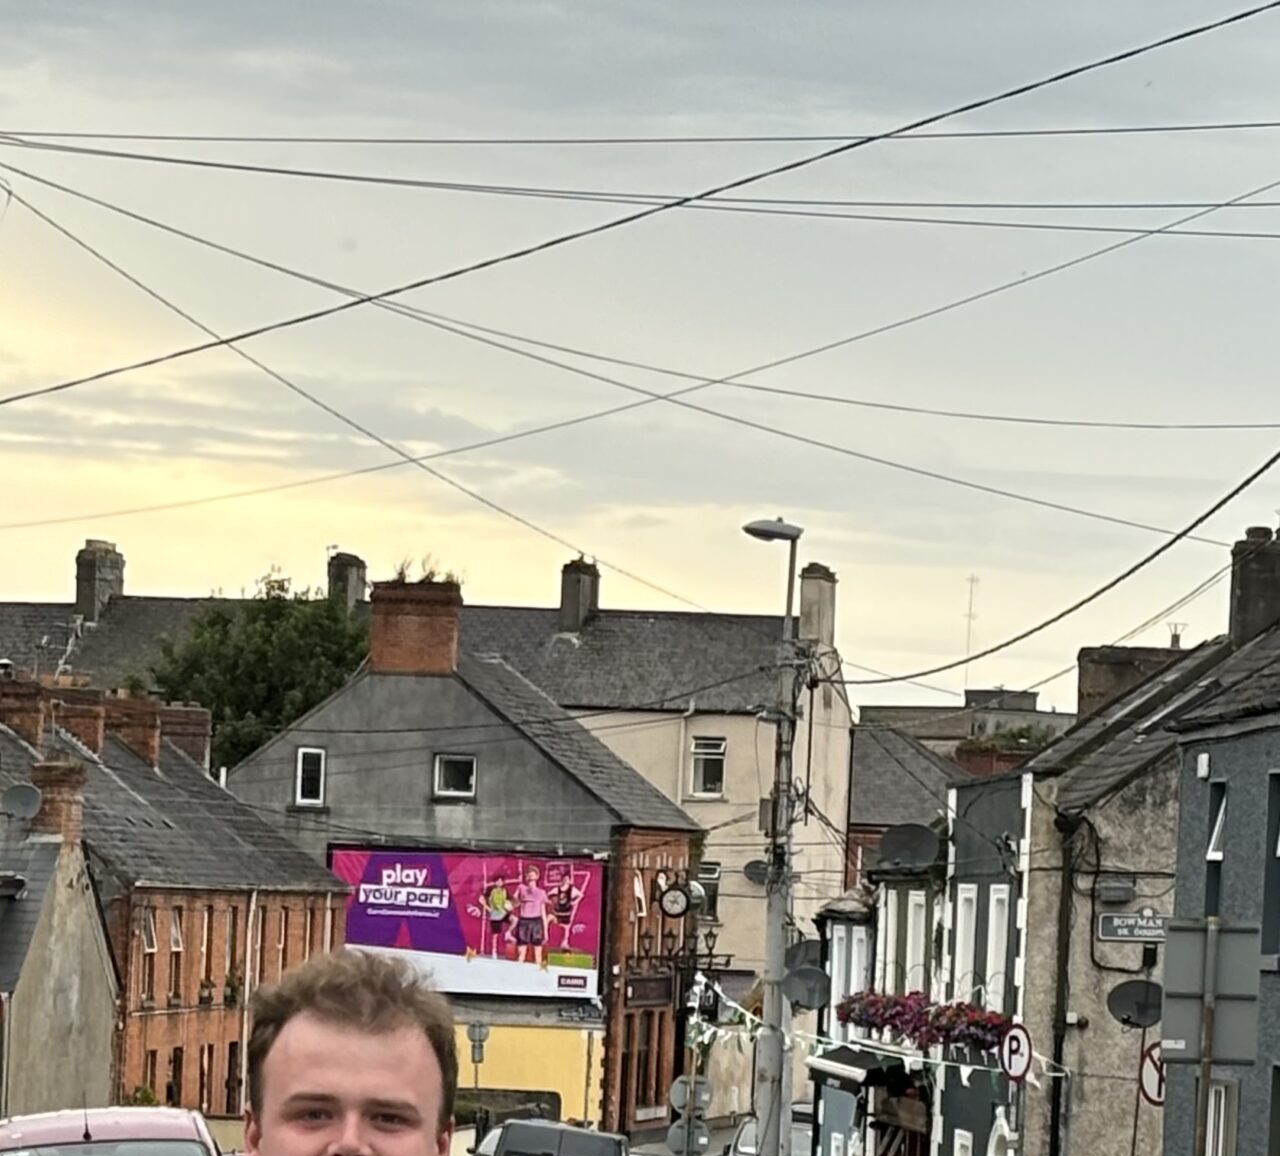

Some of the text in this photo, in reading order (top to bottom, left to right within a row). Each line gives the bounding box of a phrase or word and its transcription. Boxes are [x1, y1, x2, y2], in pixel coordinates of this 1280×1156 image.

[382, 863, 427, 888] play
[363, 887, 447, 907] your part
[1113, 917, 1162, 927] BOWMAN
